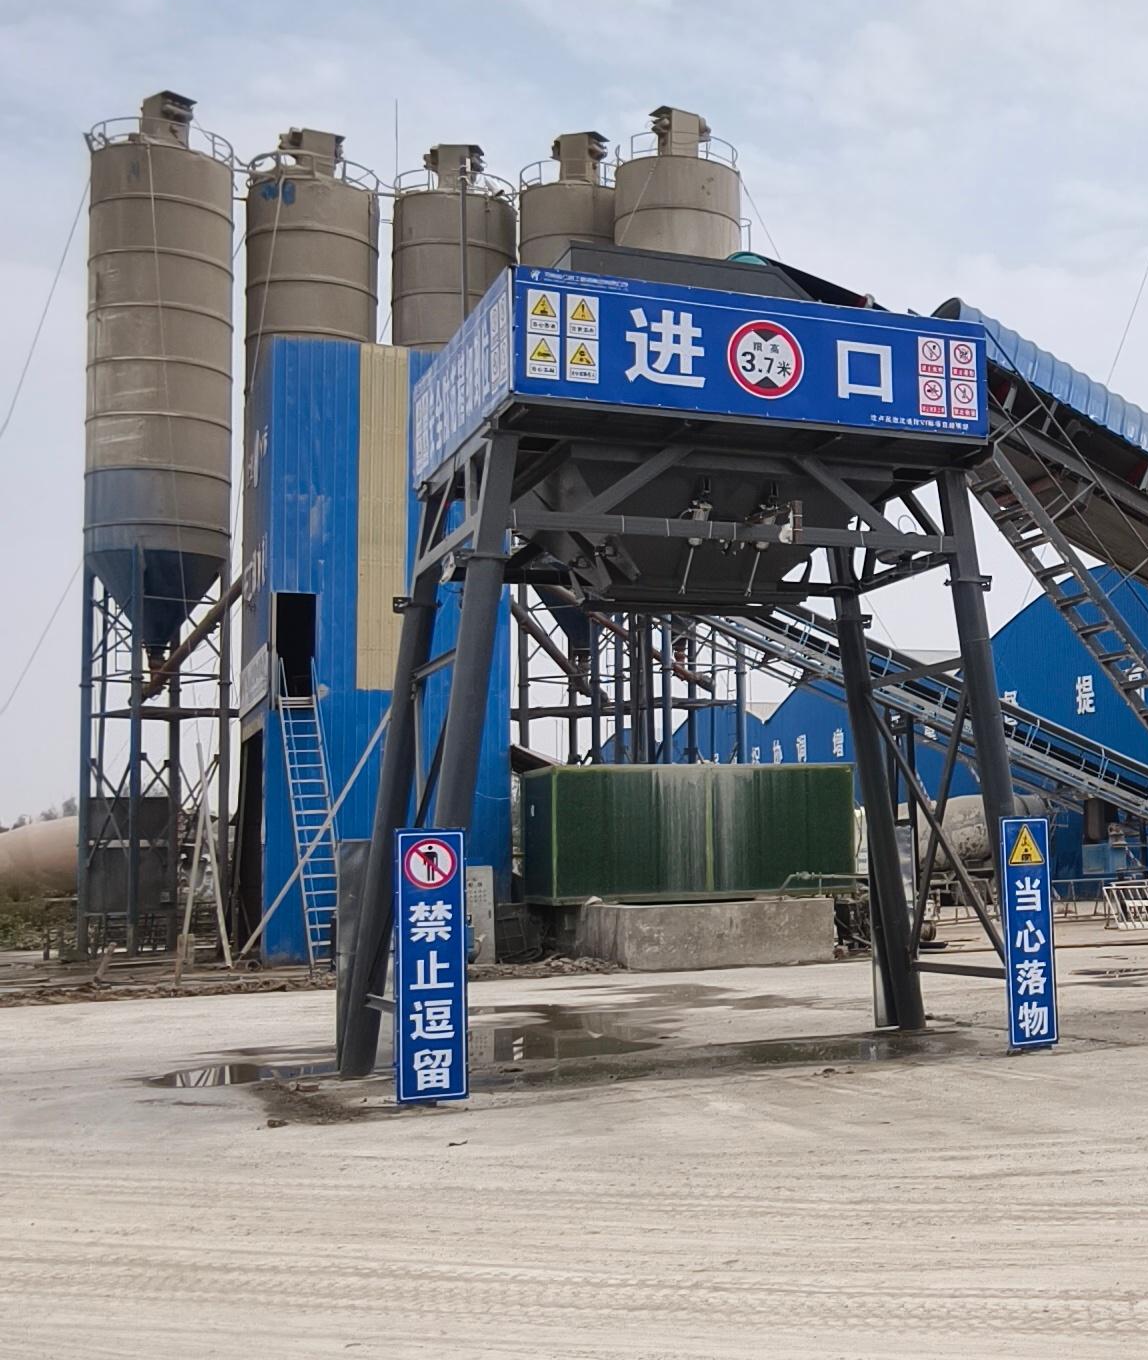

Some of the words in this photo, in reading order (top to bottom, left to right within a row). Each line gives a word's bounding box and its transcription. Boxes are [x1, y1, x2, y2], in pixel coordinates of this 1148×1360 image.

[741, 351, 792, 377] 3.7米
[753, 342, 780, 354] 限高
[408, 900, 456, 1091] 禁止逗留
[1014, 876, 1049, 1038] 当心落物
